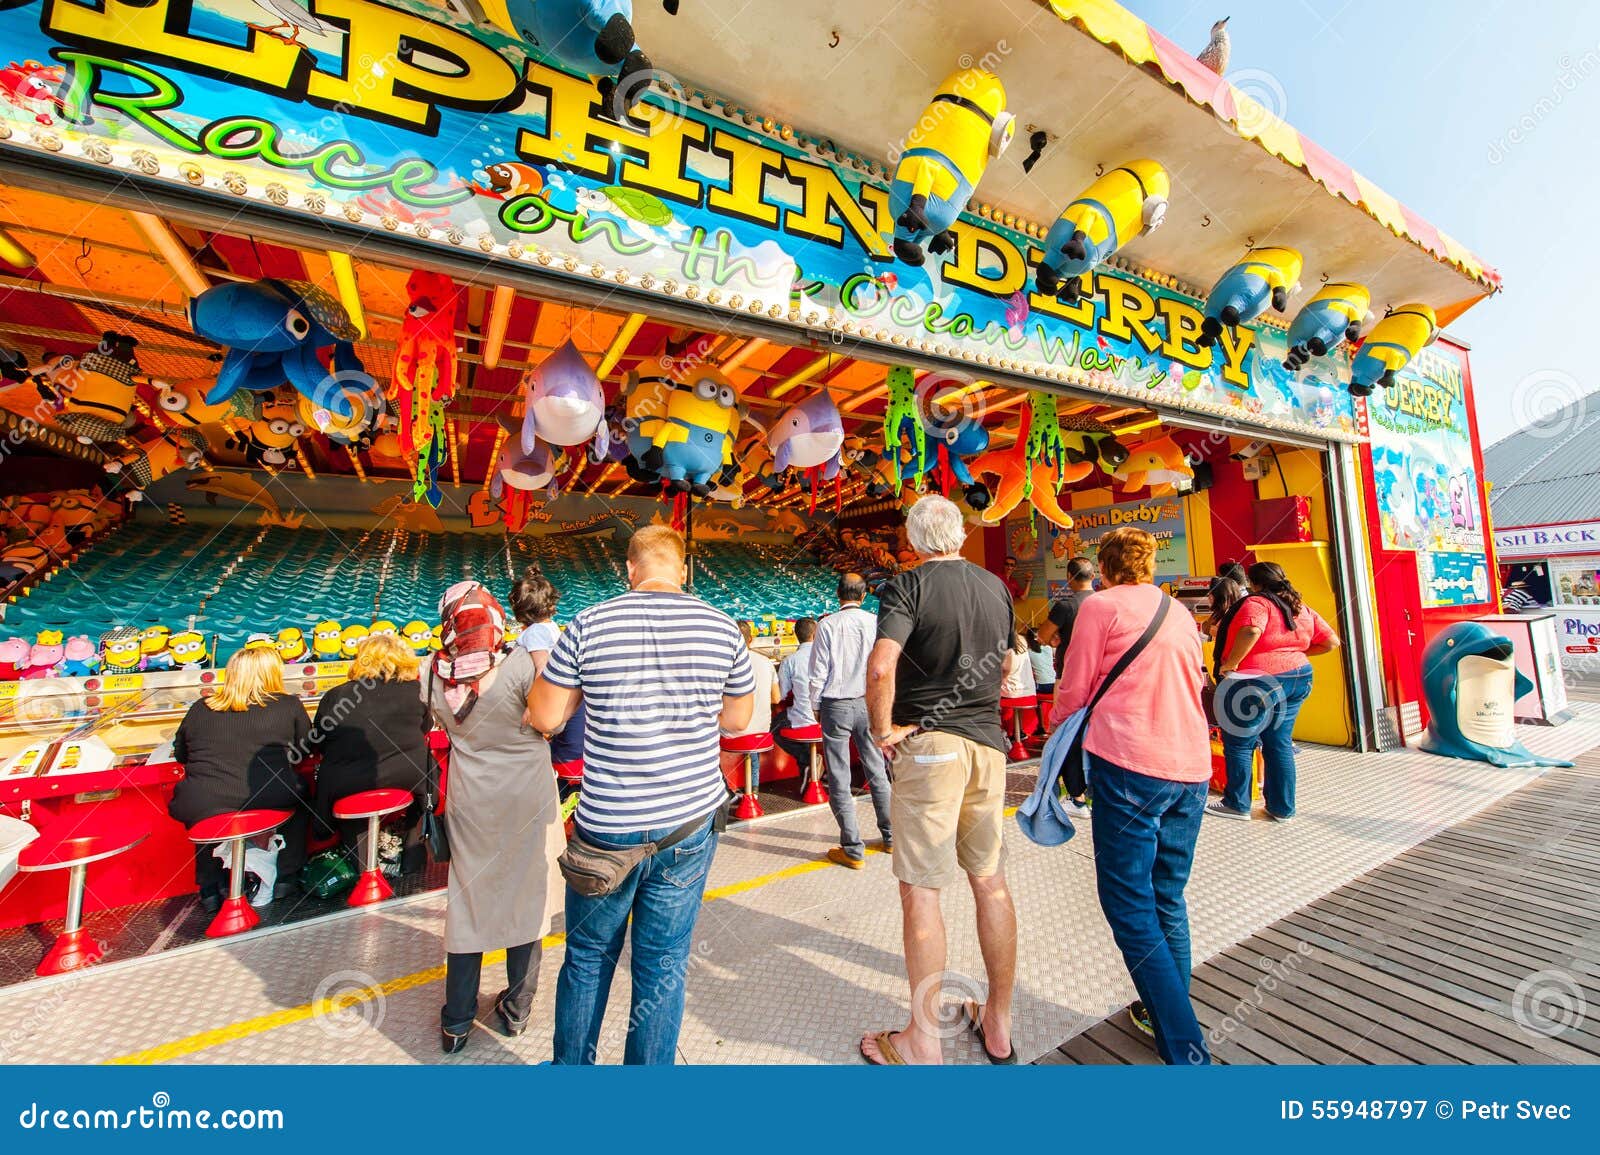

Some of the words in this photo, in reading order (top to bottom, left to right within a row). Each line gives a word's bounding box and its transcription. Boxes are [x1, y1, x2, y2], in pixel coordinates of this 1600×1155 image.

[0, 0, 896, 263] LPHIN
[941, 220, 1256, 390] DERBY
[48, 47, 476, 207] Race
[498, 192, 655, 256] on
[840, 272, 1028, 353] Ocean
[1036, 322, 1168, 391] Waves
[1109, 502, 1161, 526] Derby
[1533, 529, 1596, 545] BACK
[1564, 618, 1600, 638] Pho
